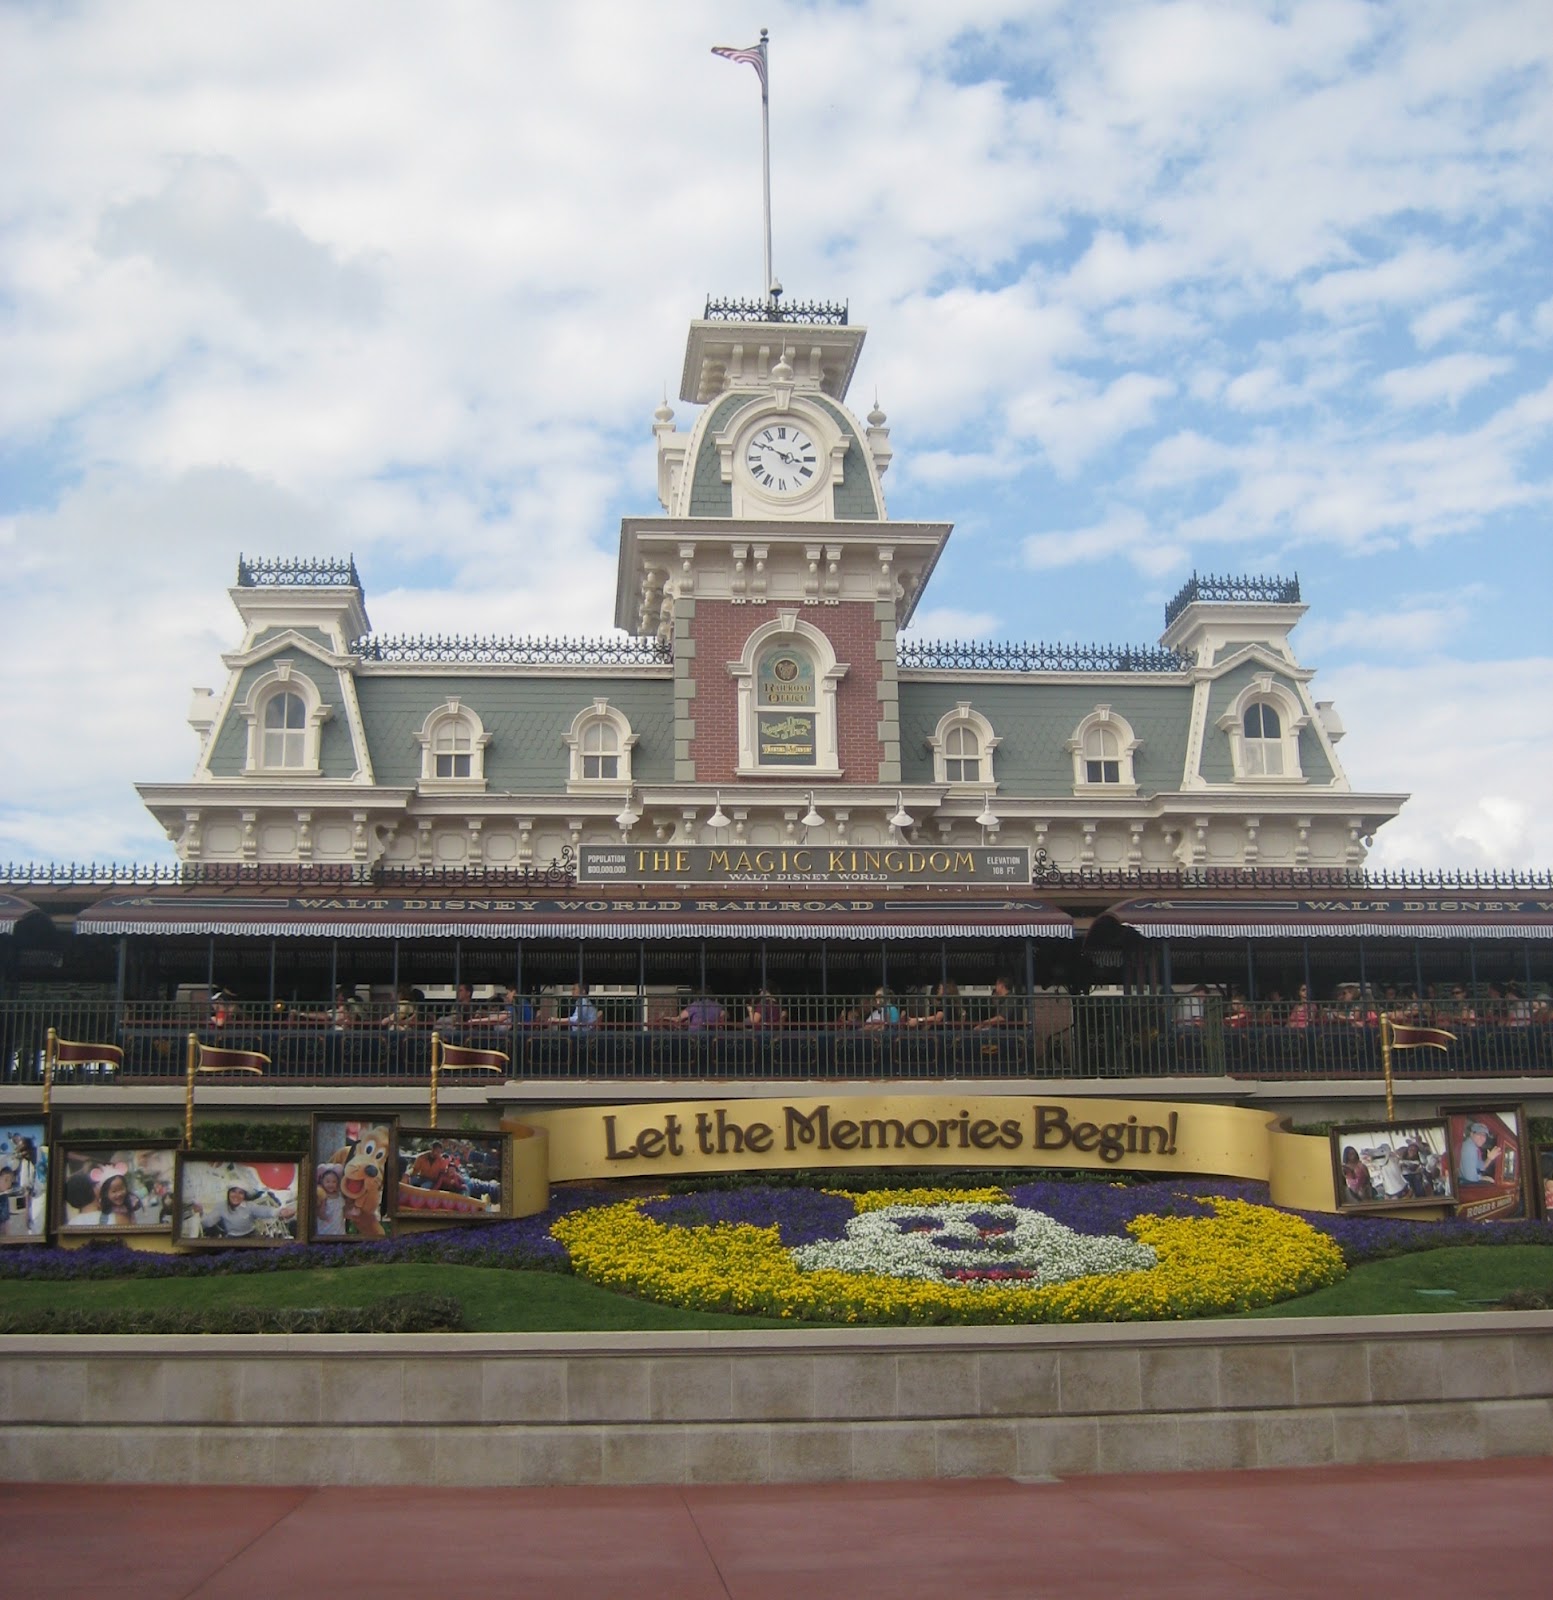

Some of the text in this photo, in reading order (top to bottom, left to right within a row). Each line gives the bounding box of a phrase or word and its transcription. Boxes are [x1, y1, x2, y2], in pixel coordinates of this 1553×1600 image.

[587, 854, 626, 863] POPULATION
[634, 850, 977, 873] THE MAGIC KINGDOM
[986, 856, 1021, 865] ELEVATION
[729, 873, 888, 881] WALT DISNEY WORLD
[296, 899, 874, 912] WALT DISNEY WORLD RAILROAD
[1305, 901, 1524, 911] WALT DISNEY
[602, 1105, 1179, 1164] Let the Memories Begin!
